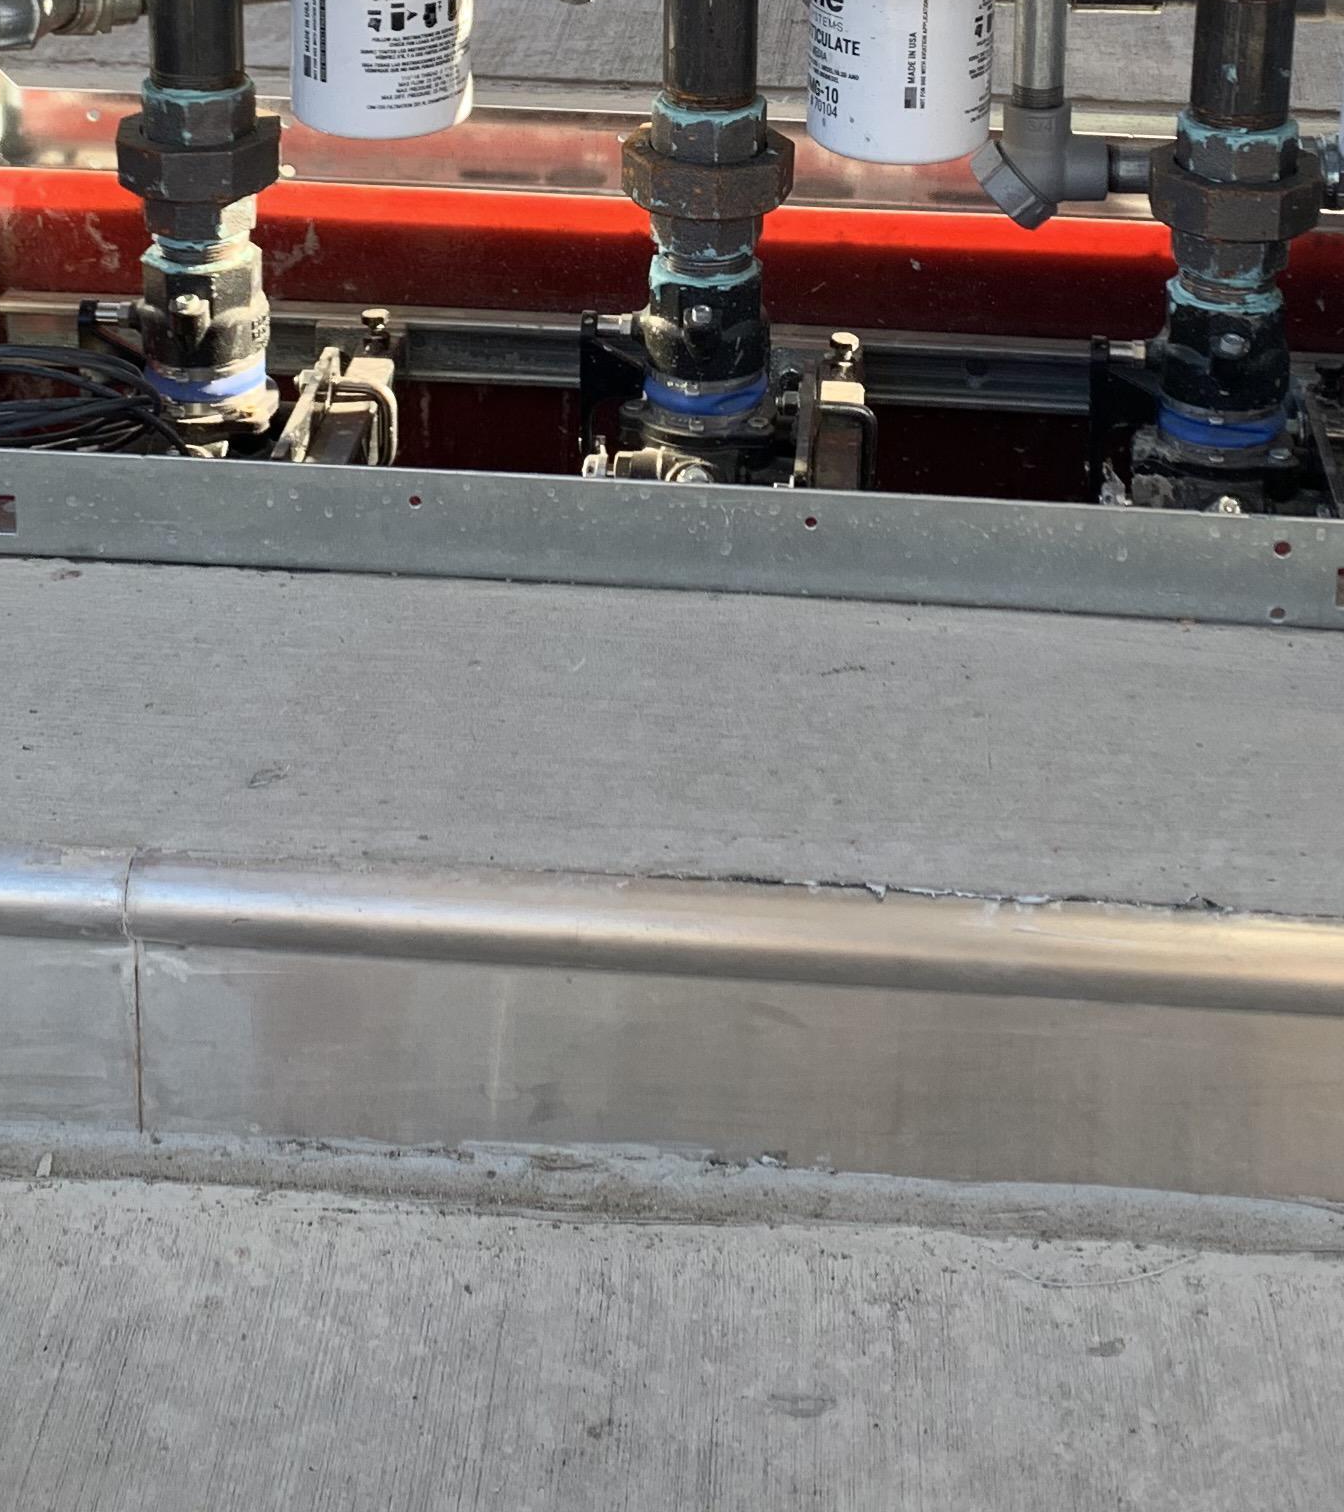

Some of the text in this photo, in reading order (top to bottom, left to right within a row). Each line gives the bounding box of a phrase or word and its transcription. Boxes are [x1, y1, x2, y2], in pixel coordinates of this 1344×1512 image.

[907, 32, 918, 84] MADE IN USA
